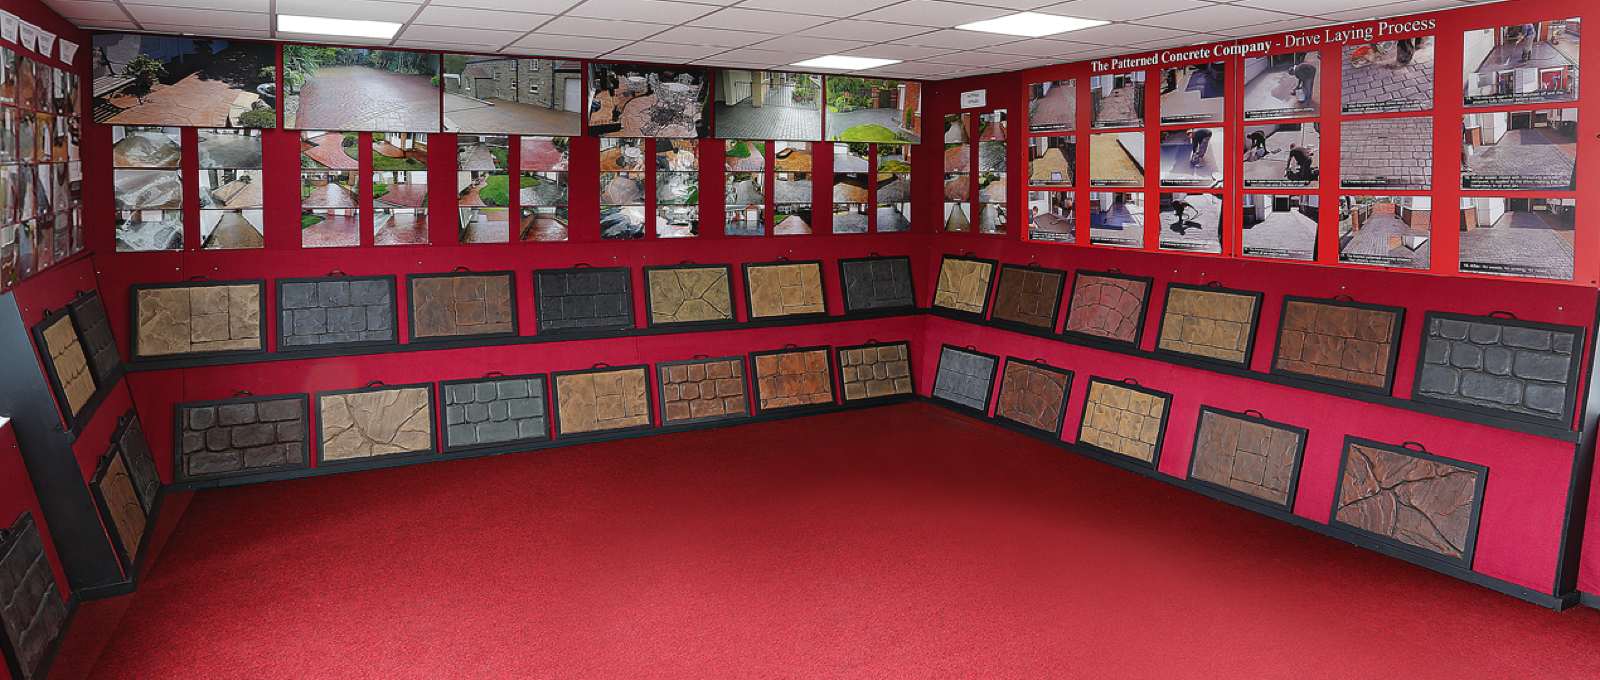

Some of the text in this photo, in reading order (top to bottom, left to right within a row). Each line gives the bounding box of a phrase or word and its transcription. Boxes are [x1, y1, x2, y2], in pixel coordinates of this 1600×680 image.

[1090, 61, 1108, 72] The
[1111, 53, 1159, 70] Patterned
[1161, 47, 1211, 64] Concrete
[1213, 39, 1272, 57] Company
[1284, 32, 1321, 48] Drive
[1325, 25, 1374, 45] Laying
[1378, 18, 1437, 36] Process
